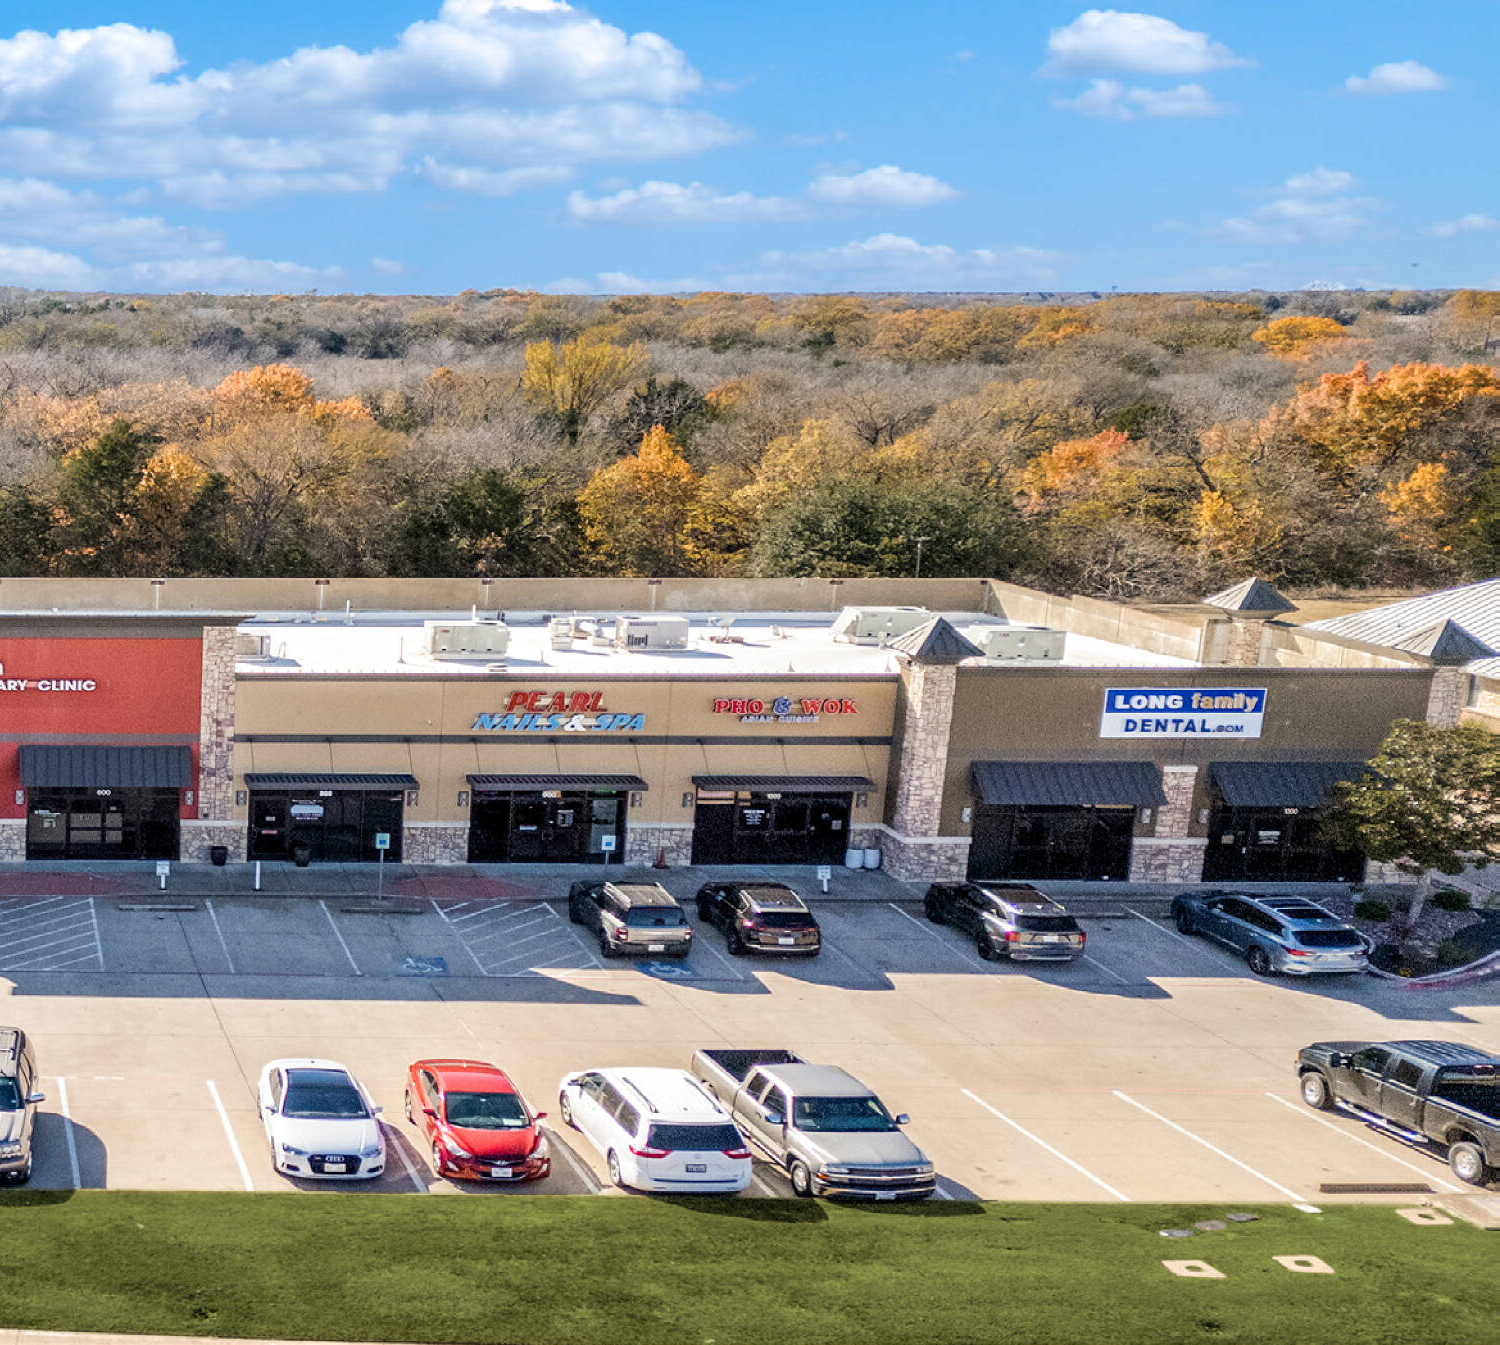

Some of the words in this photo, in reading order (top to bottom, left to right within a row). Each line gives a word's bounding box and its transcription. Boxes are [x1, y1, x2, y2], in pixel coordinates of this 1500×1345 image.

[37, 679, 96, 691] CLINIC
[505, 691, 608, 712] PEARL
[714, 699, 765, 714] PHO
[772, 696, 792, 714] &
[801, 699, 859, 714] WOK
[1114, 694, 1184, 710] LONG
[1191, 692, 1259, 713] family
[471, 713, 565, 731] NAILS
[563, 714, 587, 731] &
[590, 713, 646, 731] SPA
